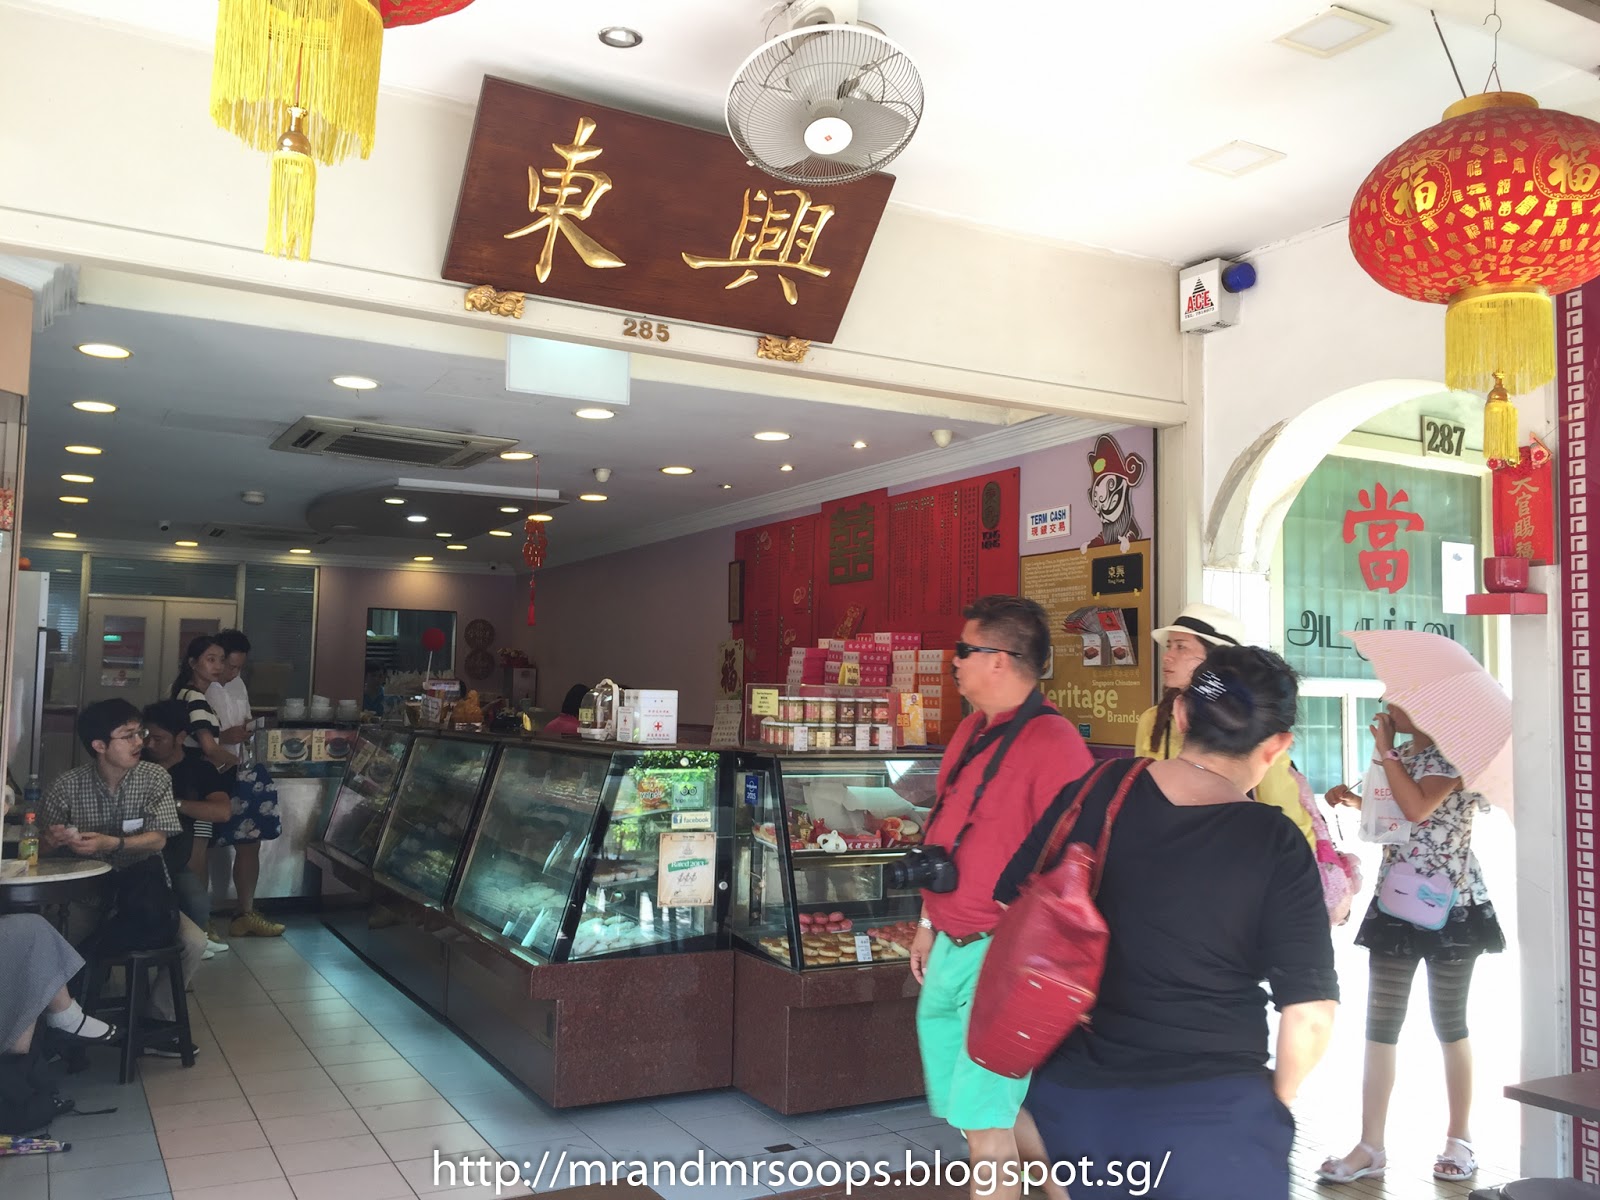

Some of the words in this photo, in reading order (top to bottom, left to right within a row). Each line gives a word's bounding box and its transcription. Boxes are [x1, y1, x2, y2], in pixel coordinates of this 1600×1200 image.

[504, 116, 836, 306] 東興
[1187, 290, 1210, 313] ACE
[623, 317, 670, 342] 285
[1426, 420, 1466, 457] 287
[1030, 513, 1048, 526] TERM
[1050, 509, 1067, 522] CASH
[1342, 481, 1425, 594] 當
[1041, 682, 1119, 718] eritage
[1107, 710, 1140, 723] Brands
[683, 815, 709, 824] facebook
[671, 860, 690, 868] Rated
